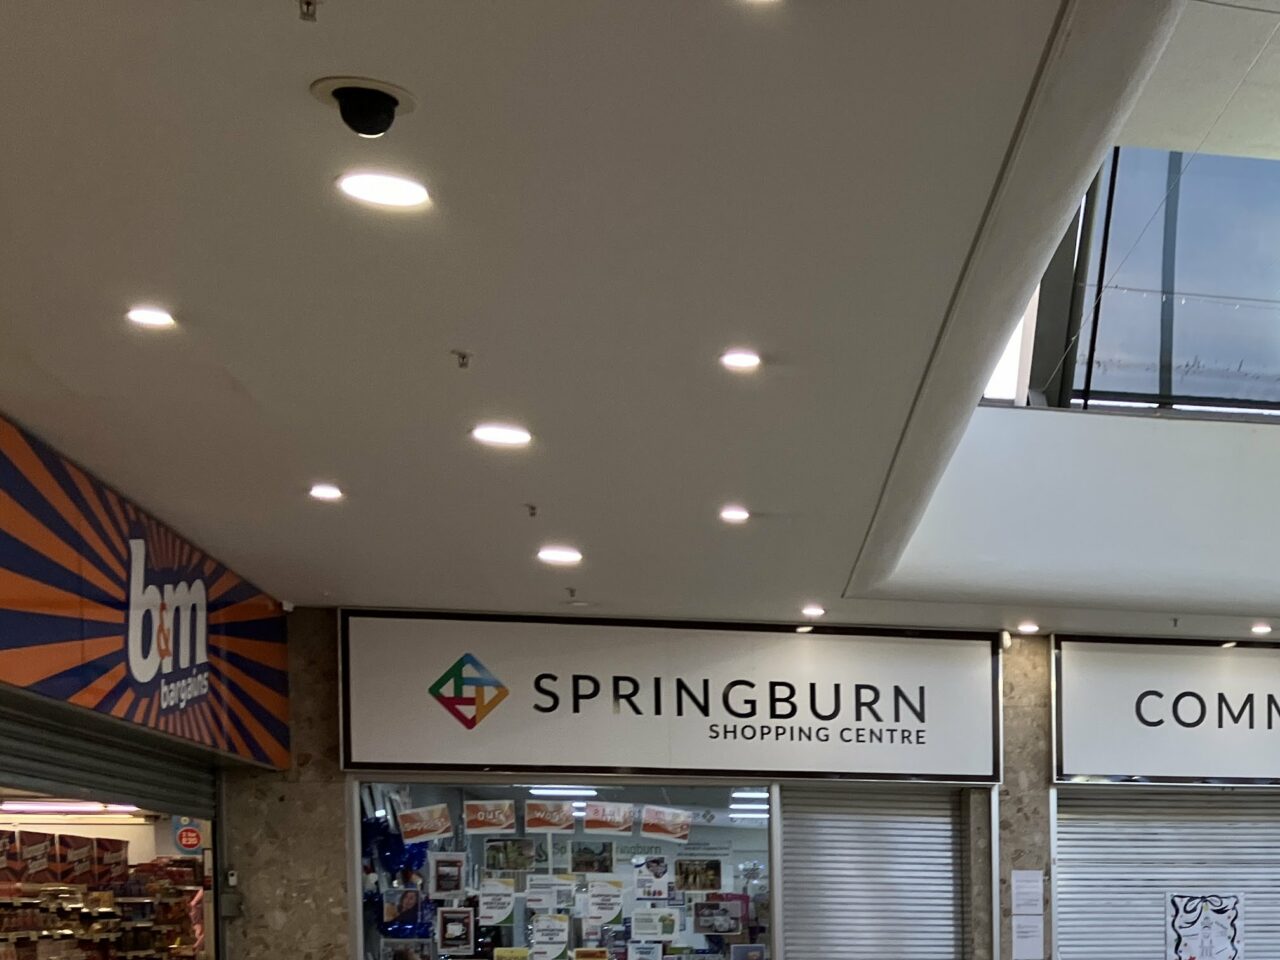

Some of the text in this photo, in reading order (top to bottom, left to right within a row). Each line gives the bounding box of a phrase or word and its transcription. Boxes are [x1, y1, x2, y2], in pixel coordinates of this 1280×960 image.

[160, 670, 210, 709] bargains
[532, 673, 928, 724] SPRINGBURN
[708, 723, 927, 745] SHOPPING CENTRE
